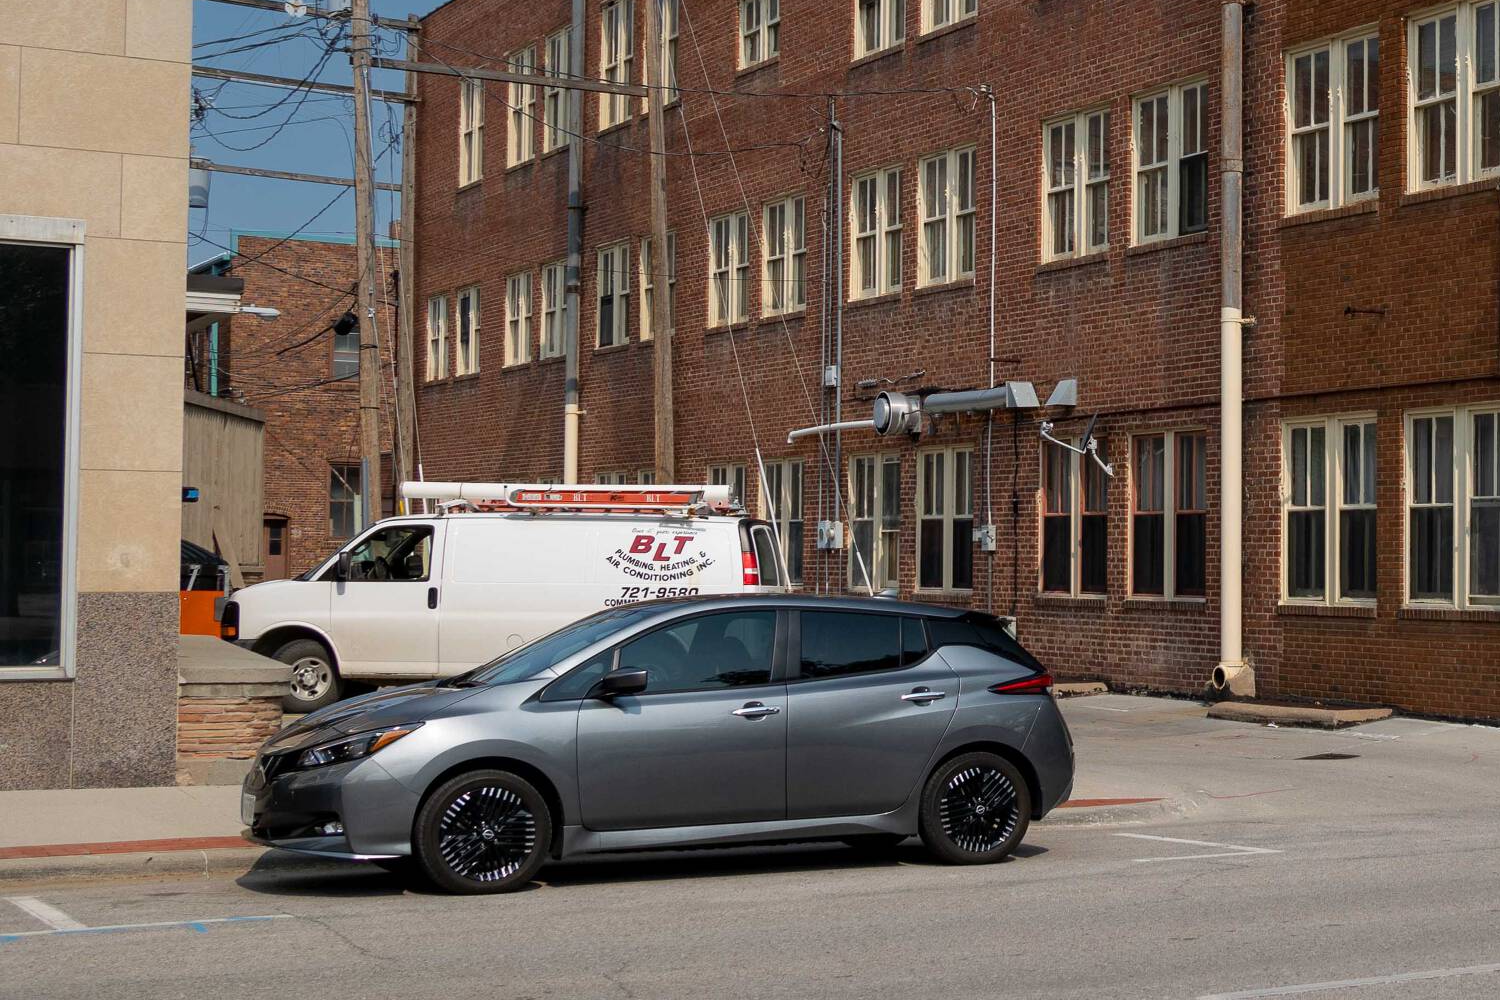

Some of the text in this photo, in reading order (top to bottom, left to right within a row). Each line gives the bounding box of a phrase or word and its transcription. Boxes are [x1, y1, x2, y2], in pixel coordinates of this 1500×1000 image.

[629, 535, 694, 562] BLT
[606, 555, 716, 582] AIR CONDITIONING INC.
